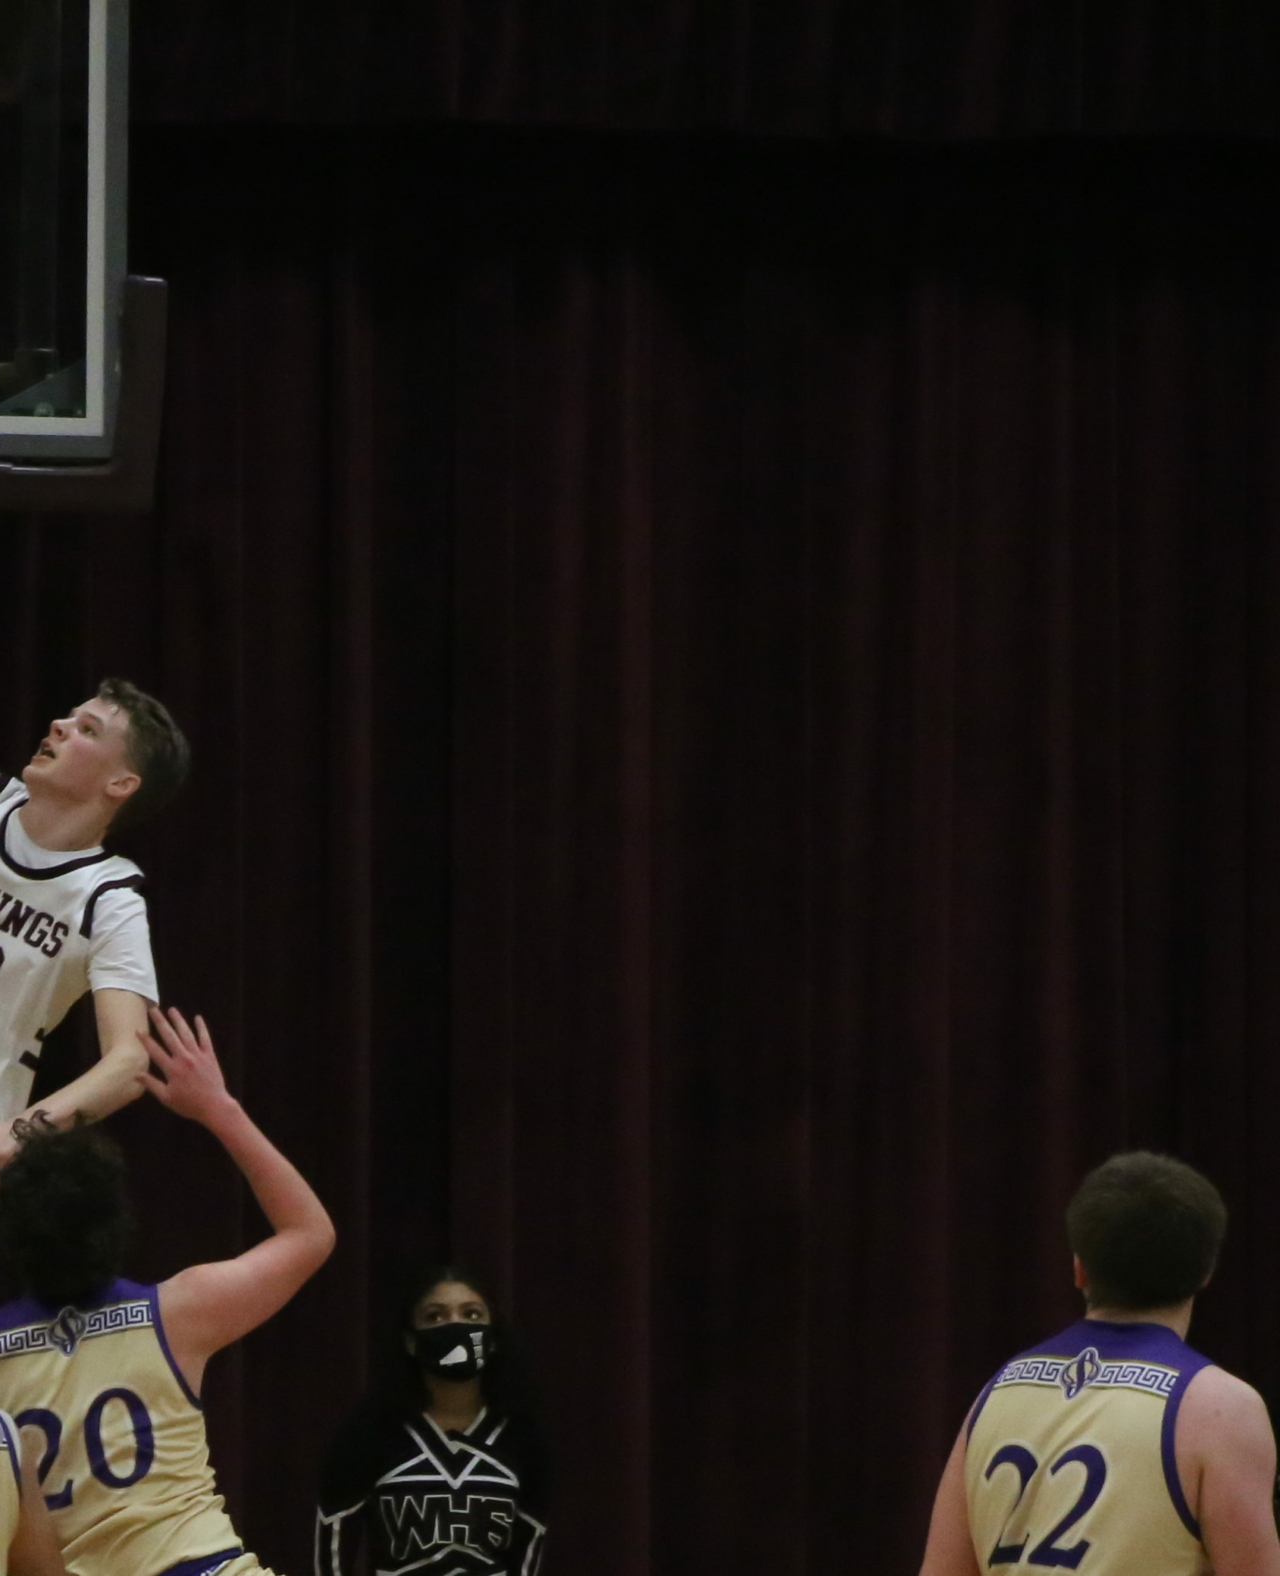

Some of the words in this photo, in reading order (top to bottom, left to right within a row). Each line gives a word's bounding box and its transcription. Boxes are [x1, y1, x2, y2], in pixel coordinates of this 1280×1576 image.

[14, 1387, 155, 1512] 20
[984, 1444, 1108, 1570] 22
[379, 1494, 516, 1561] WHS
